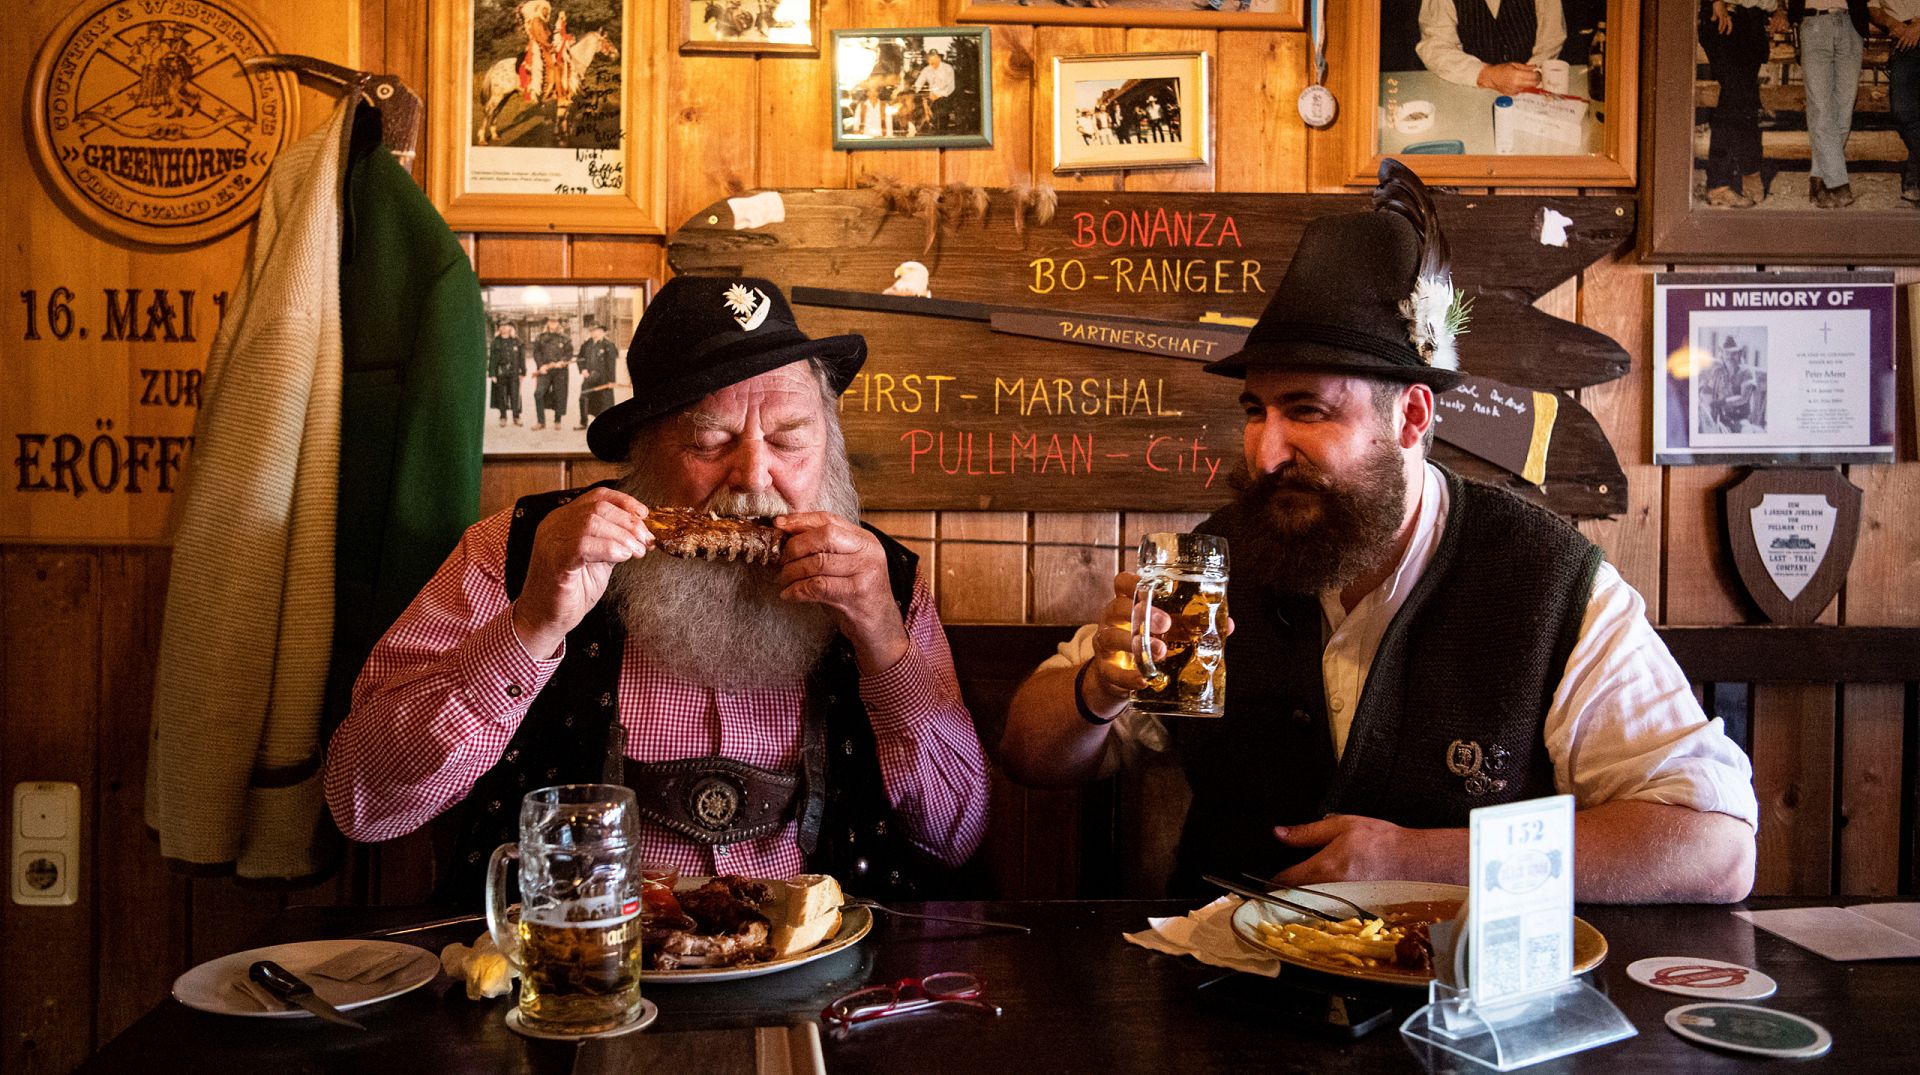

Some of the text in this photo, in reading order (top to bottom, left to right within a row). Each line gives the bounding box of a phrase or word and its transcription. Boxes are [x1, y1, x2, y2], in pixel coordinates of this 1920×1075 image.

[53, 16, 109, 131] COUNTRY
[117, 7, 133, 22] &
[82, 144, 248, 189] GREENHORNS
[1072, 207, 1242, 249] BONANZA
[1028, 257, 1267, 295] BO-RANGER
[20, 286, 88, 341] 16.
[101, 288, 196, 343] MAI
[1704, 290, 1854, 307] IN MEMORY OF
[1058, 320, 1219, 357] PARTNERSCHAFT
[139, 368, 203, 410] ZUR
[839, 373, 958, 414] FIRST
[995, 377, 1183, 416] MARSHAL
[14, 418, 196, 499] ERÖFF
[900, 429, 1093, 475] PULLMAN
[1146, 435, 1221, 489] City
[1507, 820, 1544, 845] 152
